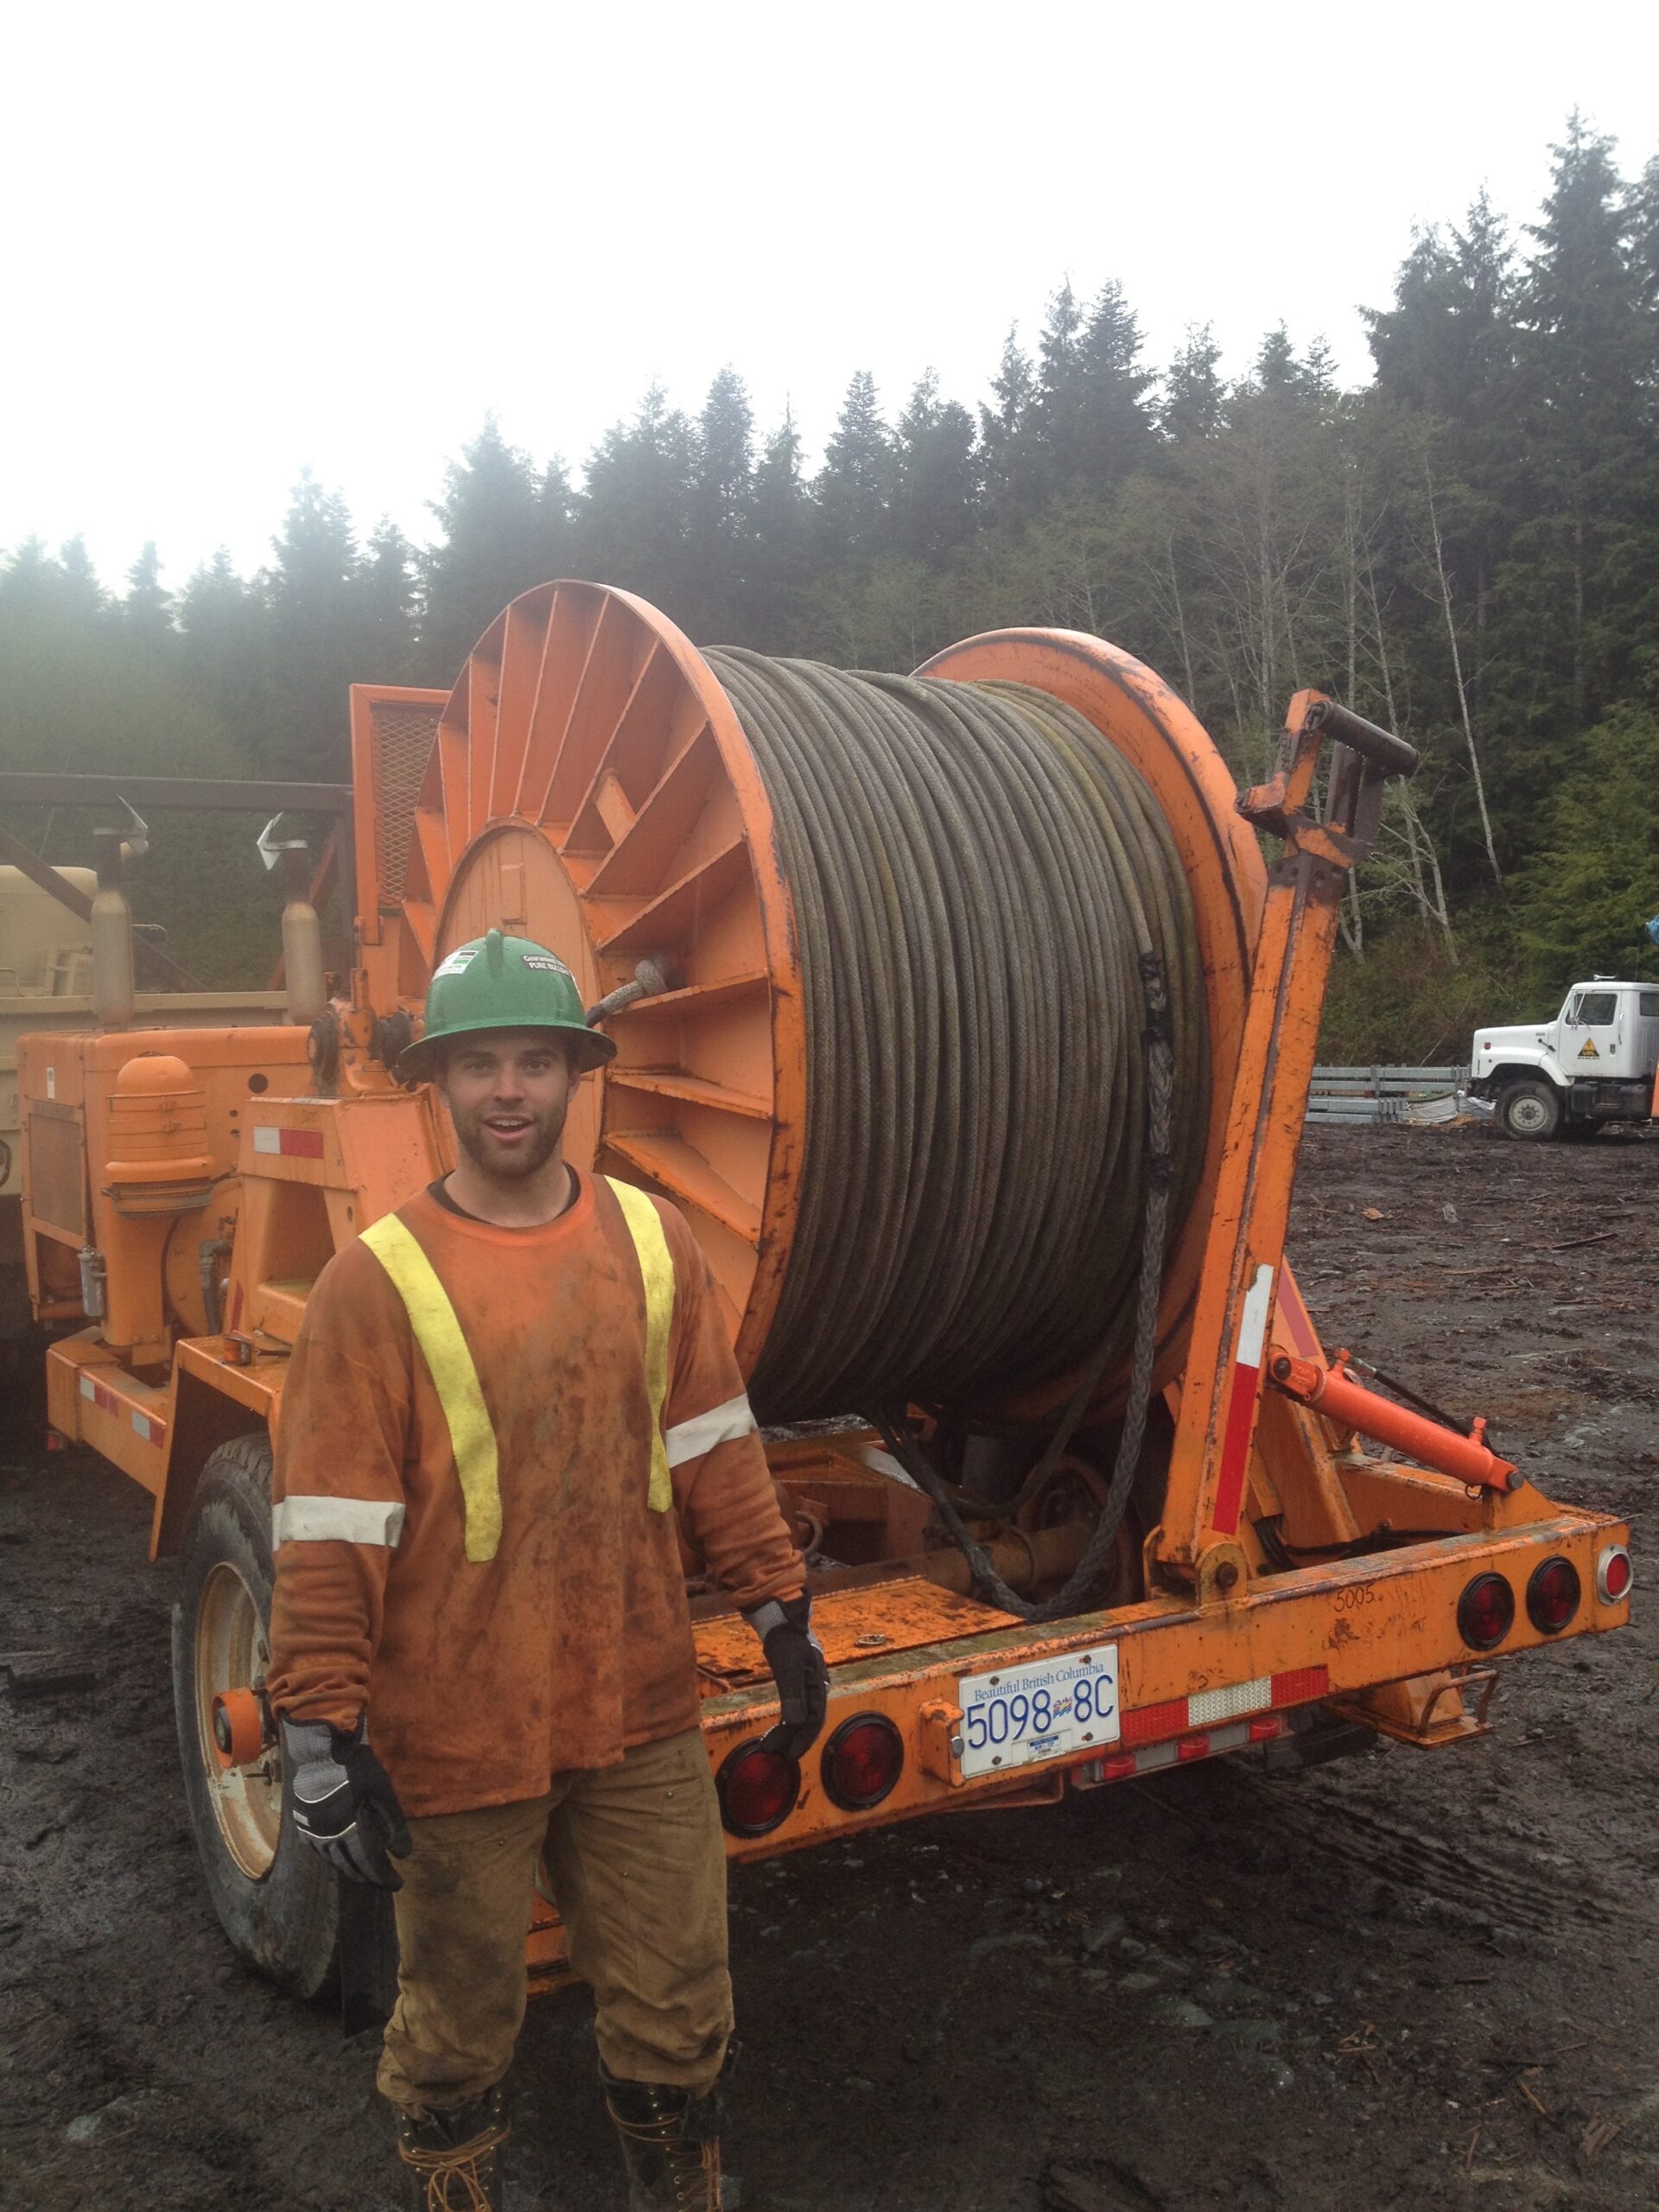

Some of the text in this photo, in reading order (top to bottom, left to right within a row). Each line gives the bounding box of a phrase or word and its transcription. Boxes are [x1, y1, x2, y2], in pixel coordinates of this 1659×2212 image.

[975, 1663, 1104, 1701] Beautiful British Columbia
[967, 1674, 1114, 1750] 5098 8C
